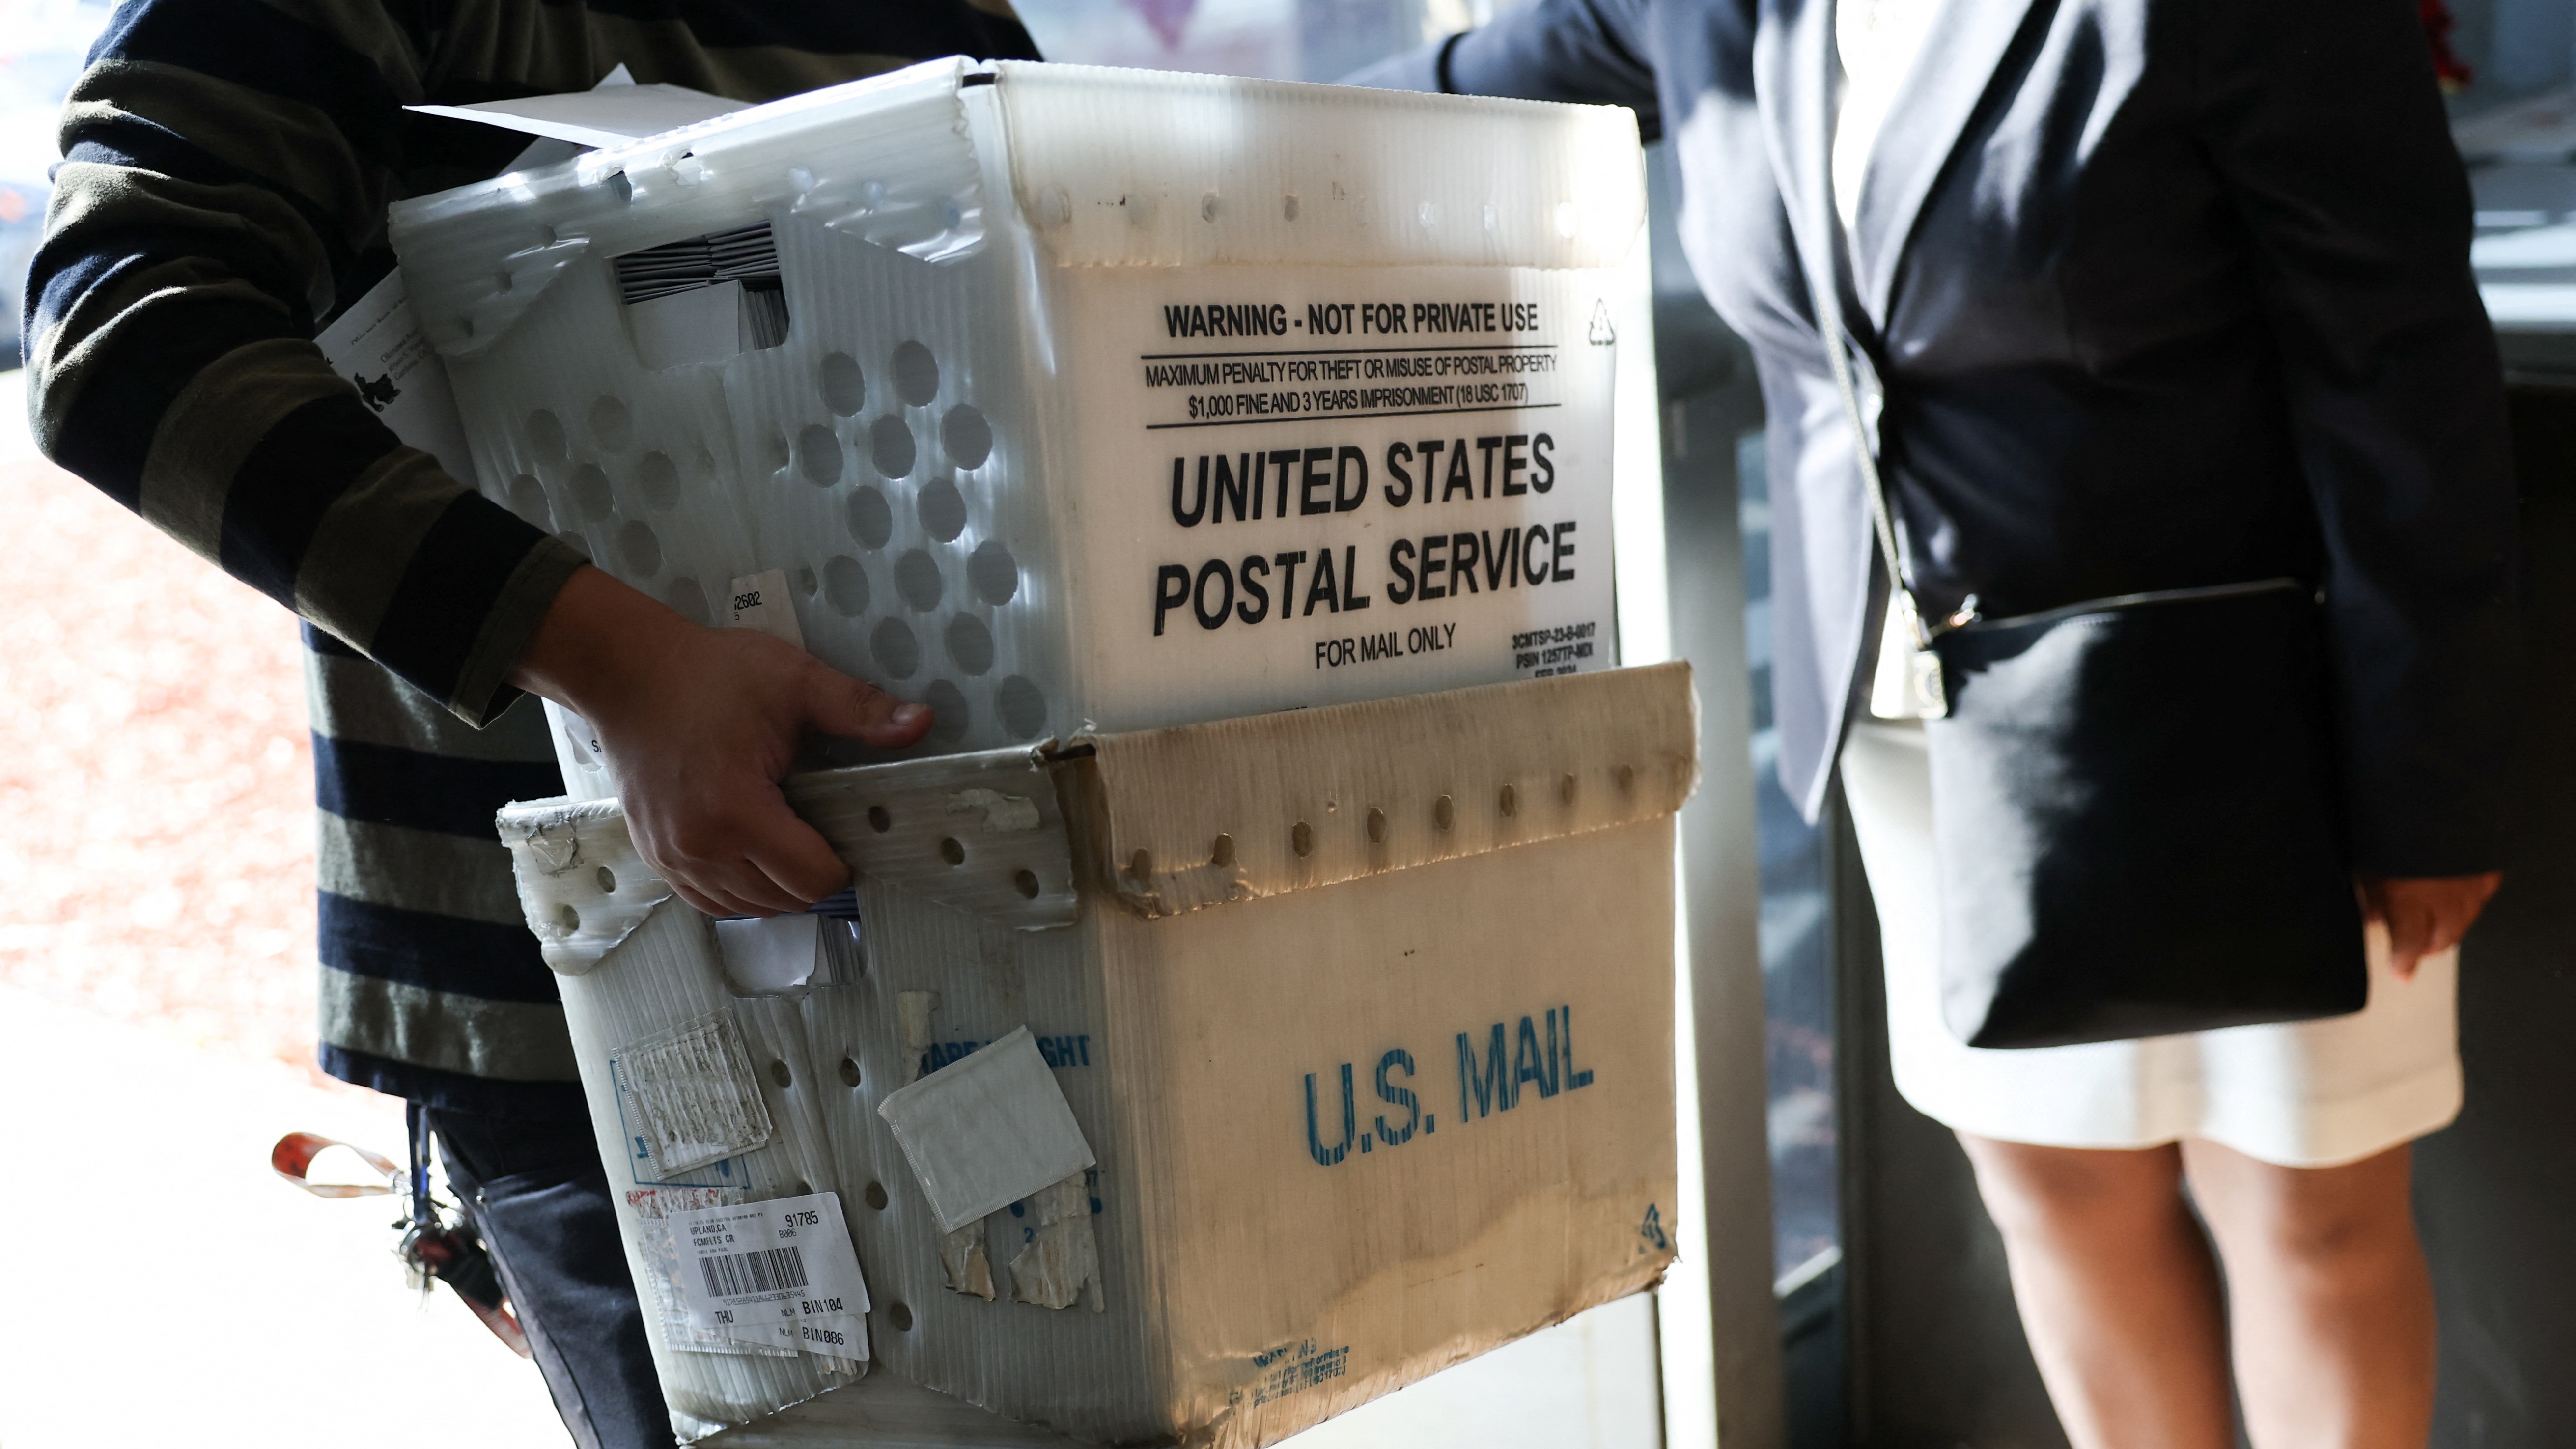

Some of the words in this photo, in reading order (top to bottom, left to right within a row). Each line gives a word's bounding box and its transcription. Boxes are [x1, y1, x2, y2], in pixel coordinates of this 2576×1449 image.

[1164, 304, 1287, 337] WARNING
[1308, 304, 1355, 335] NOT
[1362, 303, 1408, 334] FOR
[1413, 303, 1496, 333] PRIVATE
[1501, 303, 1539, 332] USE
[1146, 364, 1219, 387] MAXIMUM
[1223, 362, 1286, 384] PENALTY
[1289, 361, 1318, 382] FOR
[1319, 359, 1362, 380] THEFT
[1365, 359, 1384, 379] OR
[1386, 357, 1433, 377] MISUSE
[1435, 356, 1451, 375] OF
[1454, 355, 1498, 375] POSTAL
[1499, 354, 1557, 374] PROPERTY
[1189, 395, 1233, 419] $1,000
[1236, 393, 1269, 415] FINE
[1270, 392, 1300, 413] AND
[1303, 392, 1311, 412] 3
[1312, 390, 1358, 411] YEARS
[1361, 385, 1454, 408] IMPRISONMENT
[1457, 385, 1473, 408] (18
[1475, 383, 1499, 403] USC
[1502, 382, 1528, 406] 1707)
[1172, 446, 1369, 528] UNITED
[1384, 432, 1555, 508] STATES
[1153, 545, 1371, 637] POSTAL
[1387, 521, 1577, 605] SERVICE
[1316, 638, 1356, 669] FOR
[1361, 631, 1403, 662] MAIL
[1408, 622, 1456, 654] ONLY
[1305, 1048, 1435, 1167] U.S.
[1456, 1005, 1594, 1123] MAIL
[690, 1224, 727, 1235] UPLAND,CA
[779, 1228, 797, 1238] B006
[785, 1211, 818, 1227] 91785
[726, 1234, 734, 1243] CR
[715, 1310, 734, 1324] THU
[781, 1308, 796, 1317] NLM
[779, 1327, 793, 1337] NLM
[802, 1326, 844, 1345] BIN086
